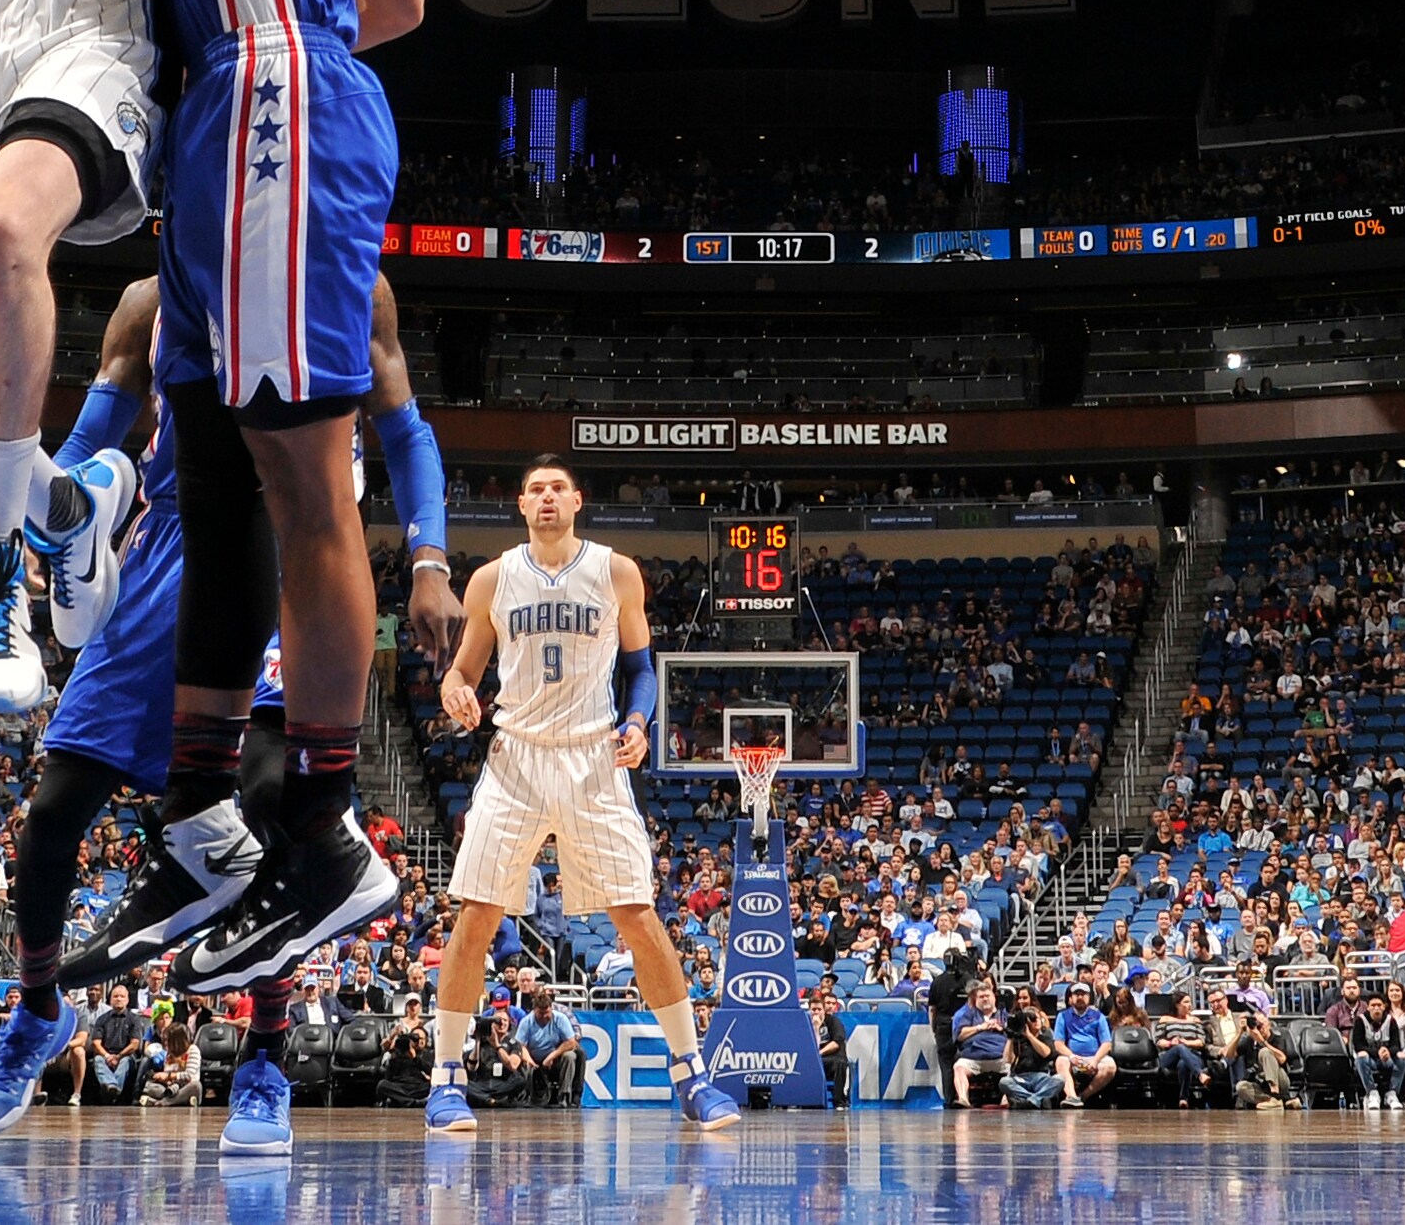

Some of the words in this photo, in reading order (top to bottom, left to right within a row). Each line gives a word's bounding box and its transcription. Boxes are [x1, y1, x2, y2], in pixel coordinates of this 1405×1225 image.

[1304, 212, 1334, 223] FIELD
[1338, 209, 1373, 220] GOALS
[420, 229, 451, 241] TEAM
[1042, 231, 1074, 242] TEAM
[1079, 231, 1094, 251] 0
[1113, 227, 1143, 239] TIME
[416, 241, 451, 253] FOULS
[456, 232, 471, 252] 0
[534, 233, 583, 255] 76ers
[638, 238, 652, 258] 2
[696, 241, 721, 255] 1ST
[757, 238, 802, 258] 10:17
[865, 238, 879, 258] 2
[1039, 243, 1074, 255] FOULS
[1112, 240, 1143, 252] OUTS
[579, 423, 639, 445] BUD
[648, 423, 729, 445] LIGHT
[741, 423, 883, 445] BASELINE
[888, 423, 947, 445] BAR
[730, 525, 786, 549] 10:16
[745, 550, 783, 591] 16
[738, 597, 795, 610] TISSOT
[508, 600, 601, 643] MAGIC
[542, 643, 563, 684] 9
[744, 870, 780, 879] SPALDING
[745, 897, 775, 910] KIA
[742, 936, 777, 952] KIA
[738, 980, 780, 998] KIA
[718, 1046, 798, 1073] Amway
[744, 1074, 786, 1084] CENTER
